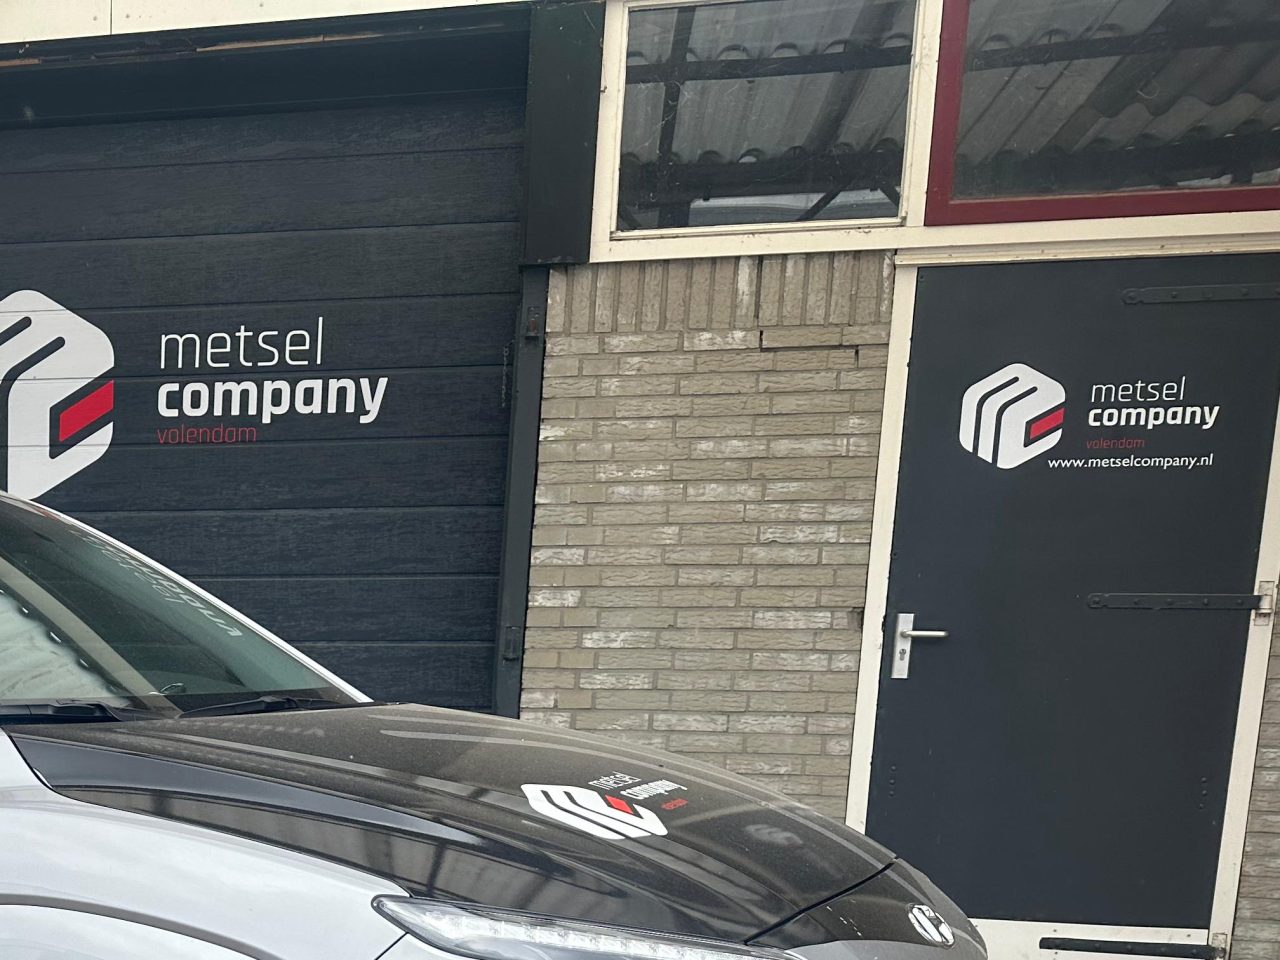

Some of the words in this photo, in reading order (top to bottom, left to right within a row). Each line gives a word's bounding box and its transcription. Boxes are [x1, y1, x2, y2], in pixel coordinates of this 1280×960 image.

[160, 316, 324, 370] metsel
[157, 376, 389, 424] company
[1090, 375, 1186, 403] metsel
[1088, 405, 1220, 430] company
[157, 424, 258, 445] volendam
[1085, 436, 1145, 450] volendam
[1048, 453, 1214, 470] www.metselcompany.nl
